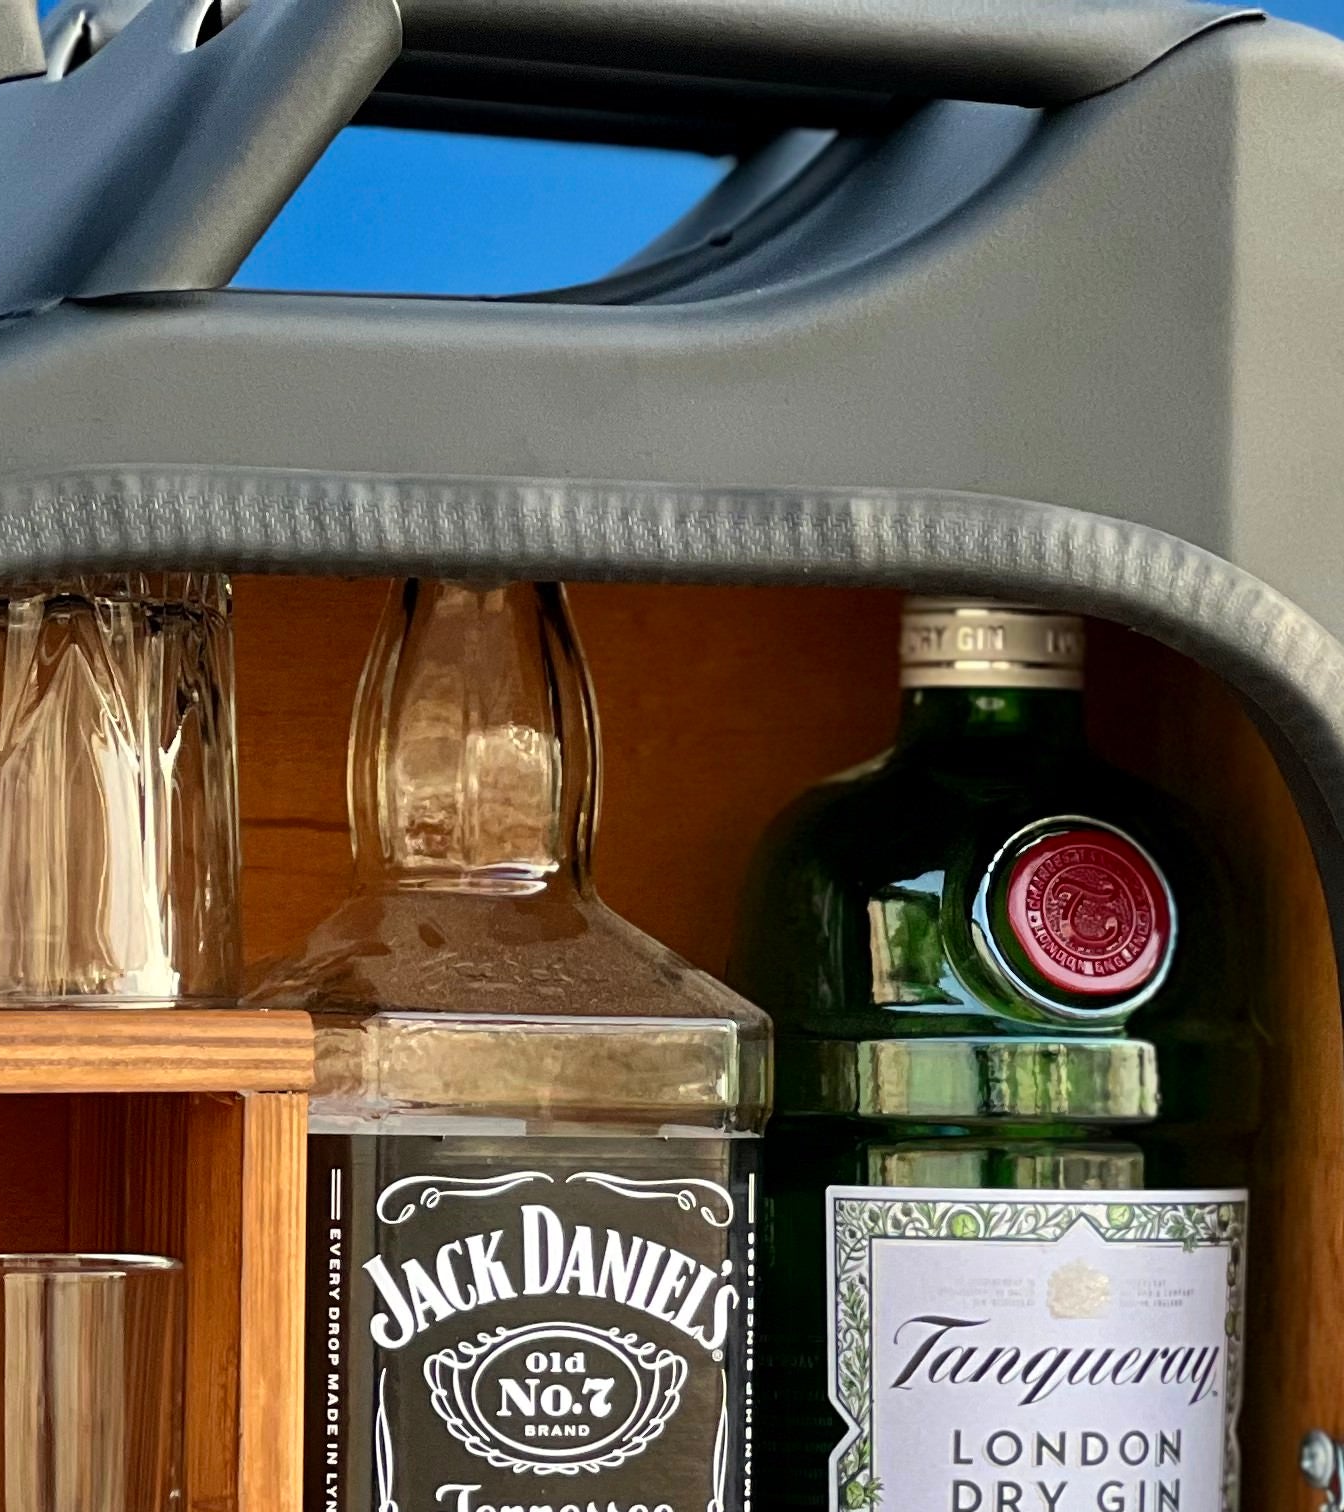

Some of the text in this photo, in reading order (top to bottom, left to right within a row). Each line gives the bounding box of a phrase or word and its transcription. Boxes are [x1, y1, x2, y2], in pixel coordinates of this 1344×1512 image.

[958, 625, 1005, 651] GIN
[328, 1228, 341, 1300] EVERY
[362, 1229, 517, 1349] JACK
[327, 1307, 340, 1366] DROP
[525, 1351, 586, 1373] Old
[327, 1374, 339, 1436] MADE
[524, 1424, 590, 1437] BRAND
[952, 1428, 1182, 1467] LONDON
[326, 1443, 338, 1465] IN
